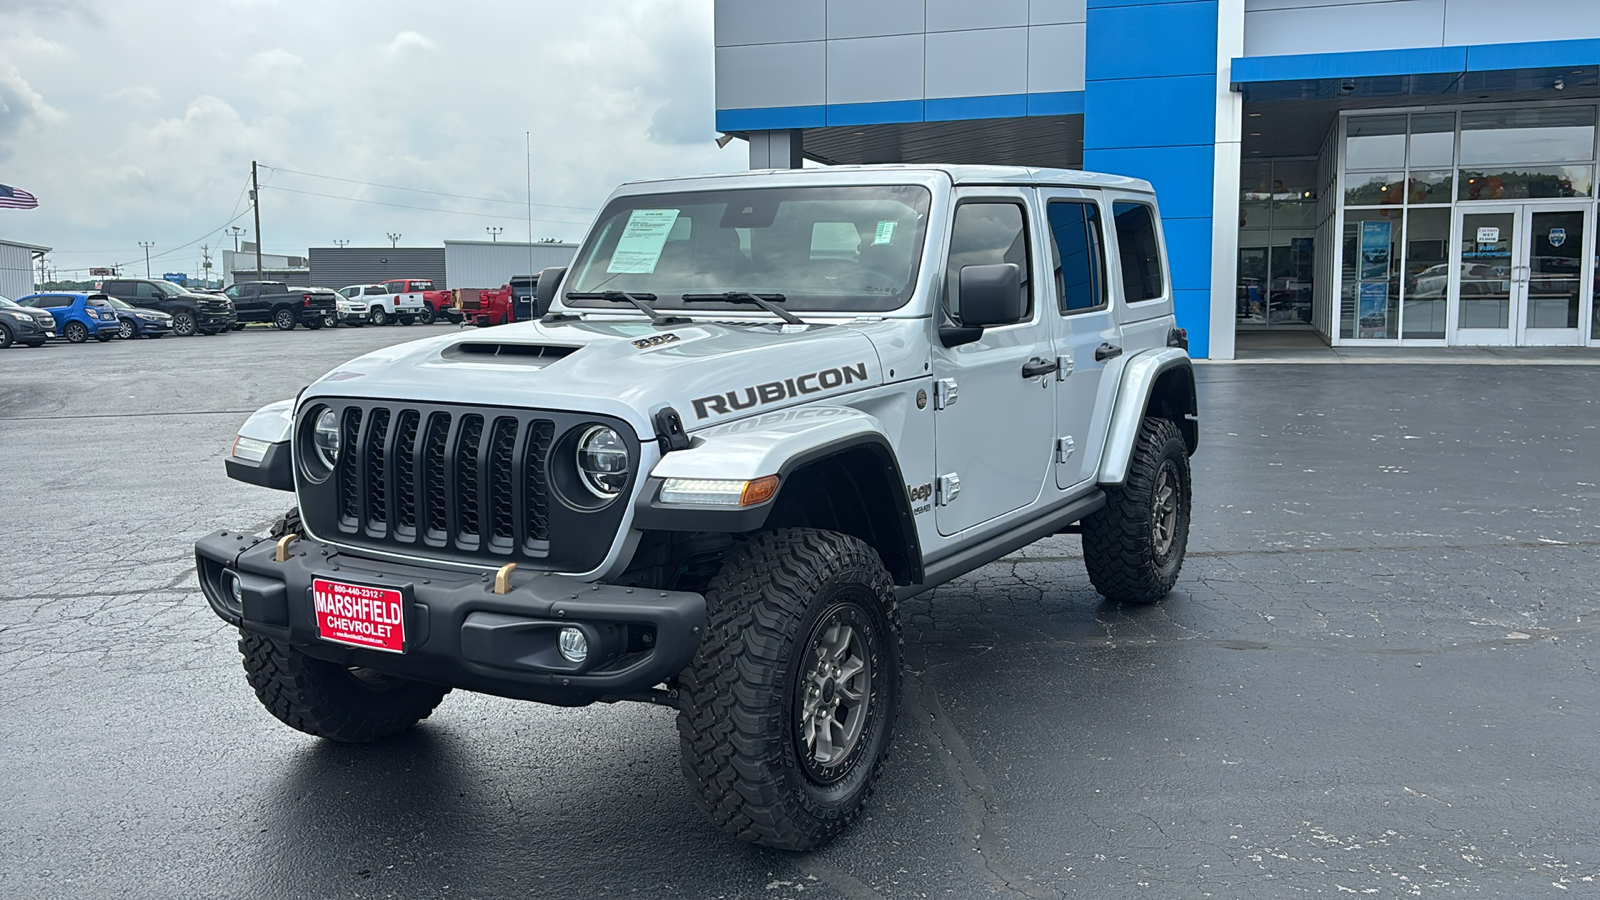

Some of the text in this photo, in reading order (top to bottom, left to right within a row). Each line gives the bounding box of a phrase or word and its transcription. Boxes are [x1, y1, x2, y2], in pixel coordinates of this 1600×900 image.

[690, 362, 868, 420] RUBICON
[334, 584, 379, 599] 800-440-2312
[315, 591, 401, 625] MARSHFIELD
[326, 615, 393, 638] CHEVROLET
